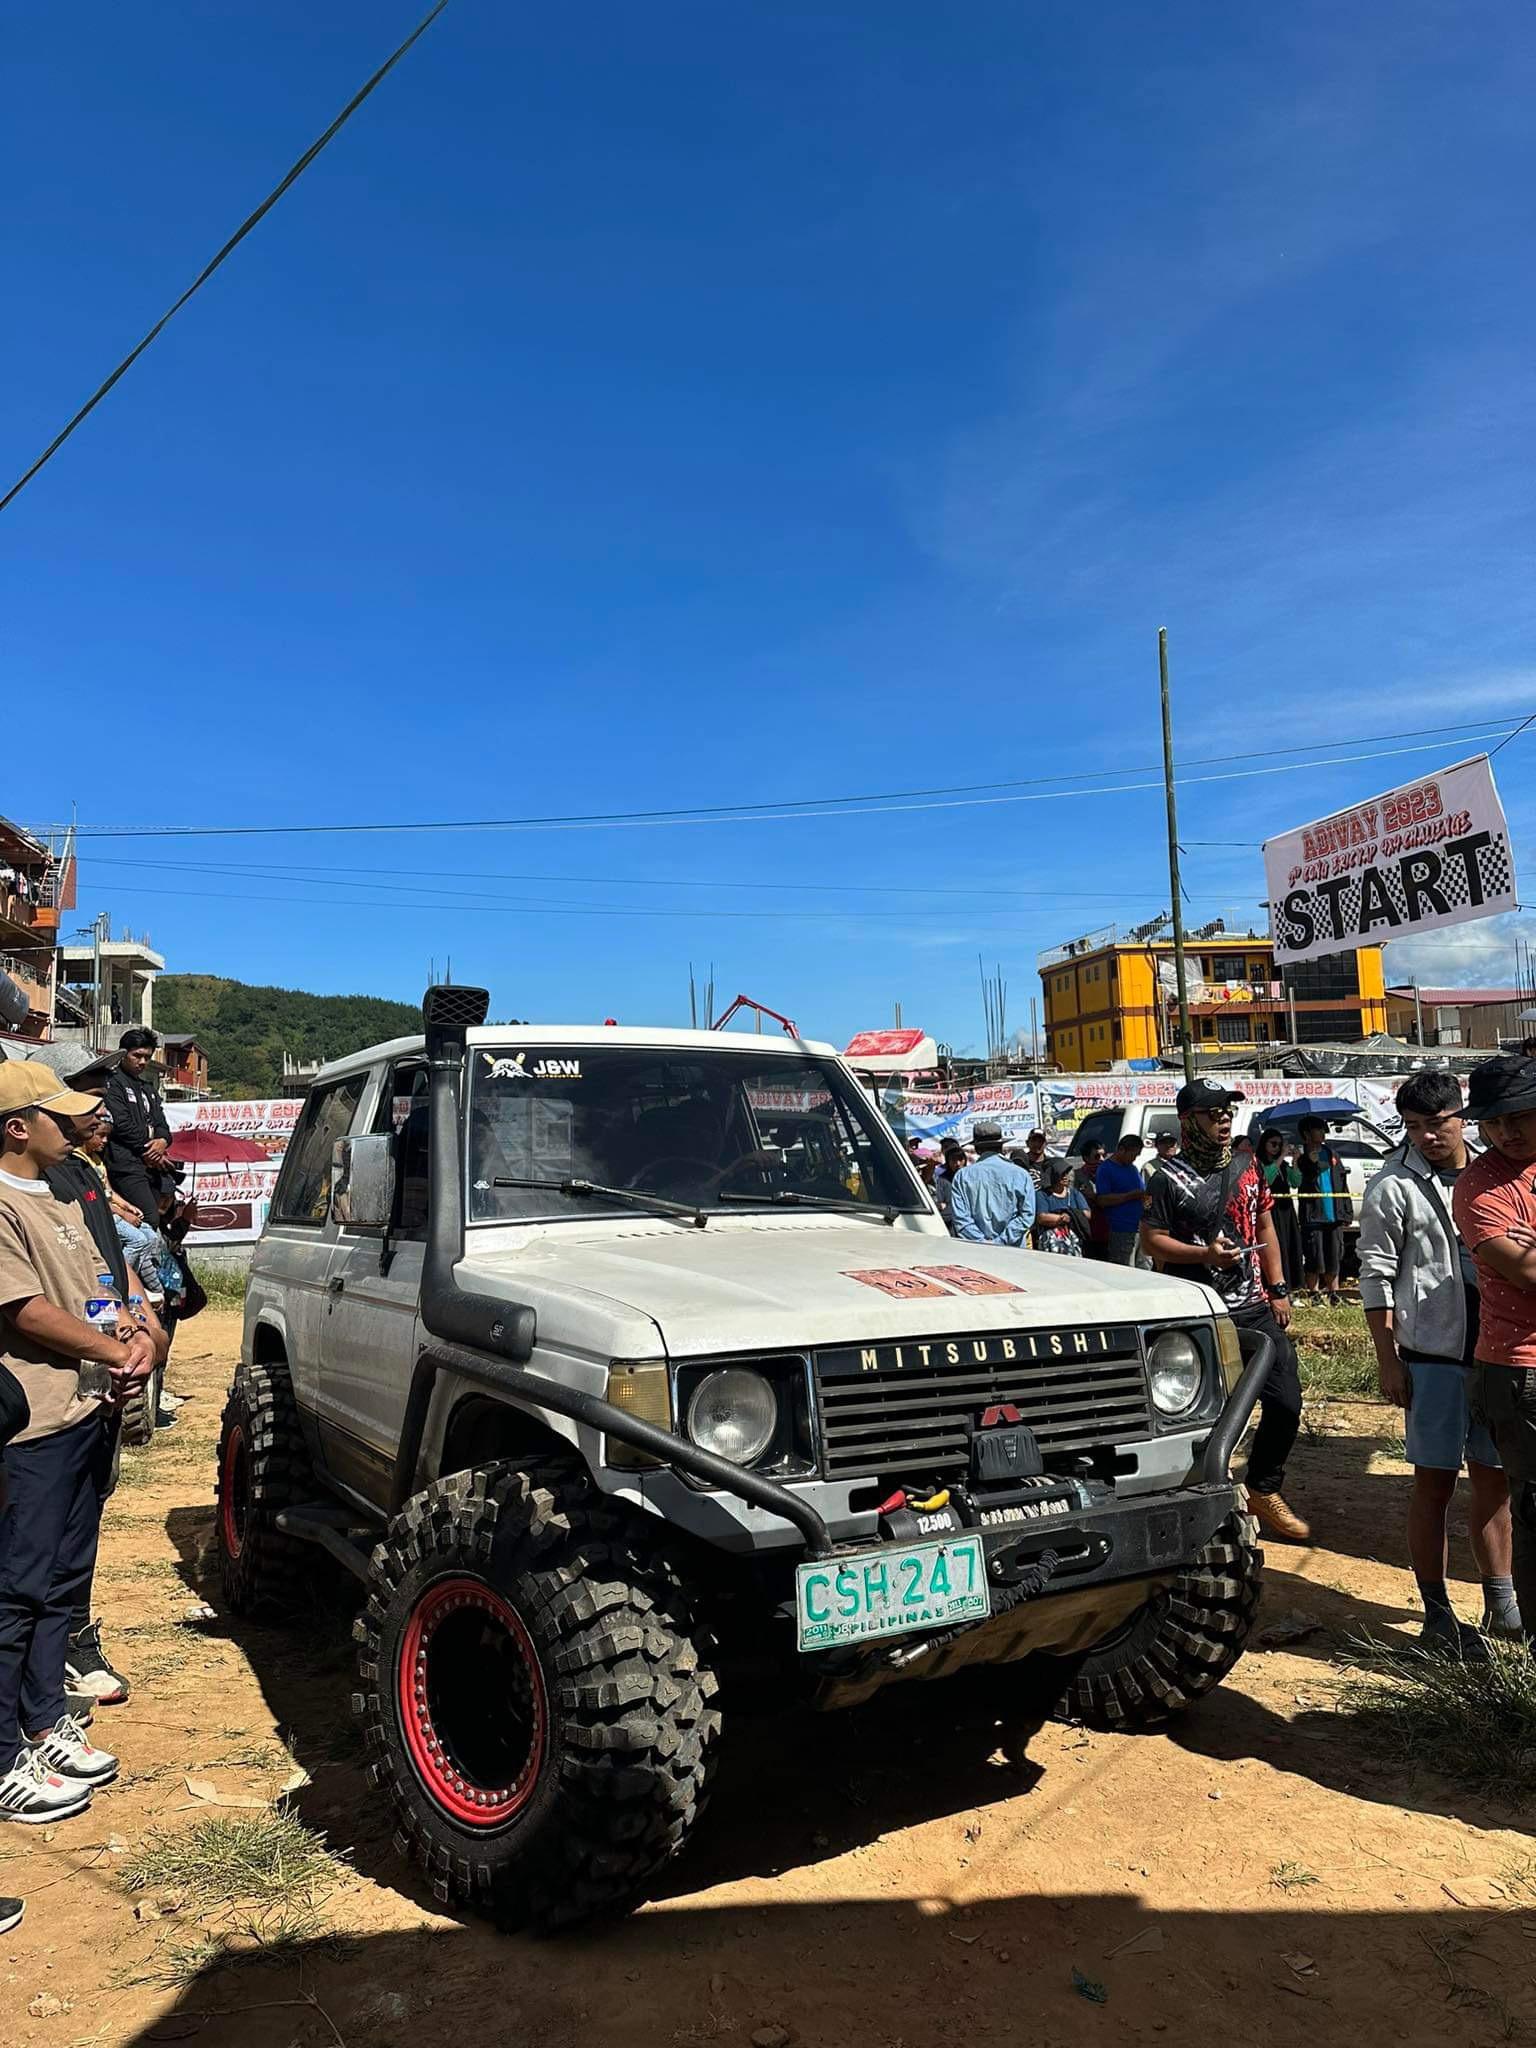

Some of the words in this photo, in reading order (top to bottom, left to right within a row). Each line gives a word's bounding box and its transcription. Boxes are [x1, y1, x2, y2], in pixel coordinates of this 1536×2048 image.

[1302, 810, 1379, 862] ADIVAY
[1383, 781, 1443, 833] 2023
[1283, 830, 1491, 950] START
[532, 1060, 580, 1075] J&W
[1074, 1084, 1132, 1097] ADIVAY
[1137, 1083, 1176, 1097] 2023
[1233, 1082, 1292, 1097] ADIVAY
[1296, 1081, 1334, 1096] 2023
[195, 1104, 267, 1120] ADIVAY
[195, 1173, 266, 1190] ADIVAY
[860, 1330, 1109, 1371] MITSUBISHI
[805, 1560, 889, 1623] CSH
[900, 1546, 976, 1606] 247
